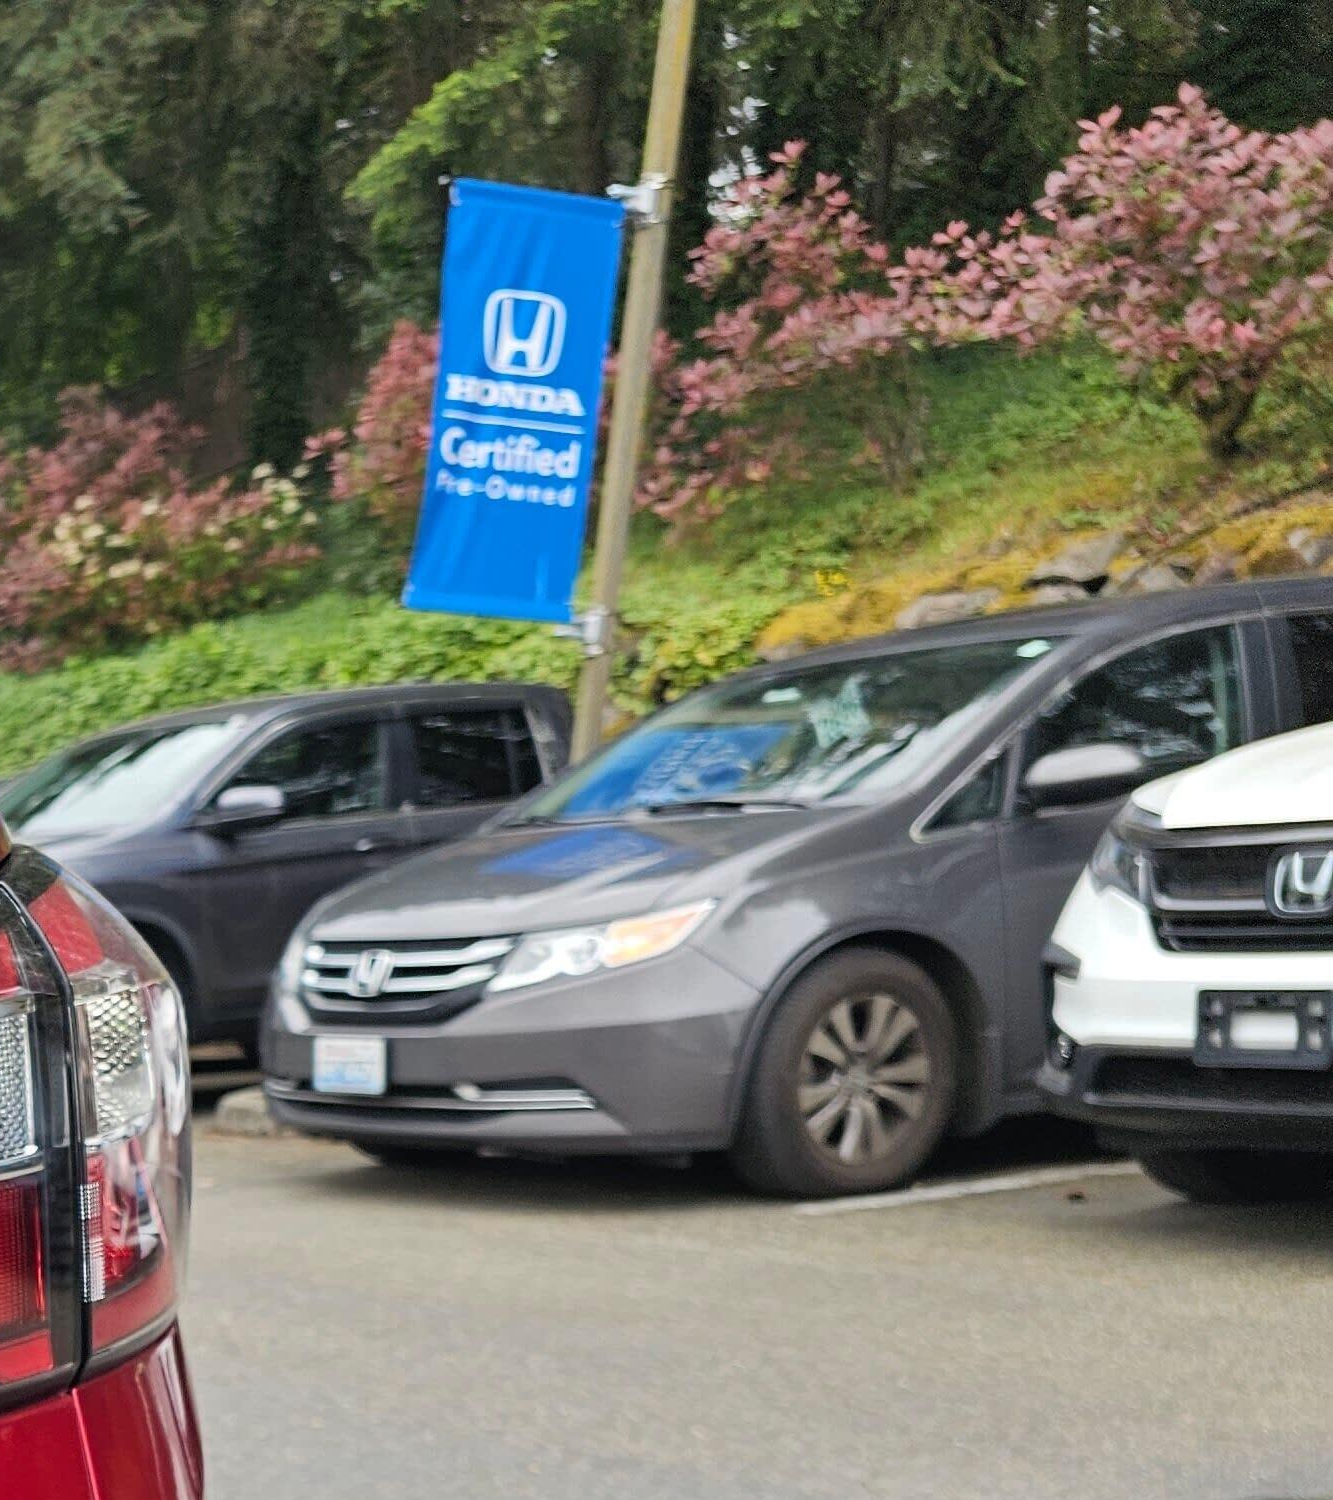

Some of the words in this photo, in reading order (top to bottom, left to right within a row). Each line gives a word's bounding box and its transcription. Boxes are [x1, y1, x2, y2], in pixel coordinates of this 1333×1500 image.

[446, 373, 586, 417] HONDA
[440, 426, 581, 479] Certified
[435, 468, 576, 508] Pre-Owned
